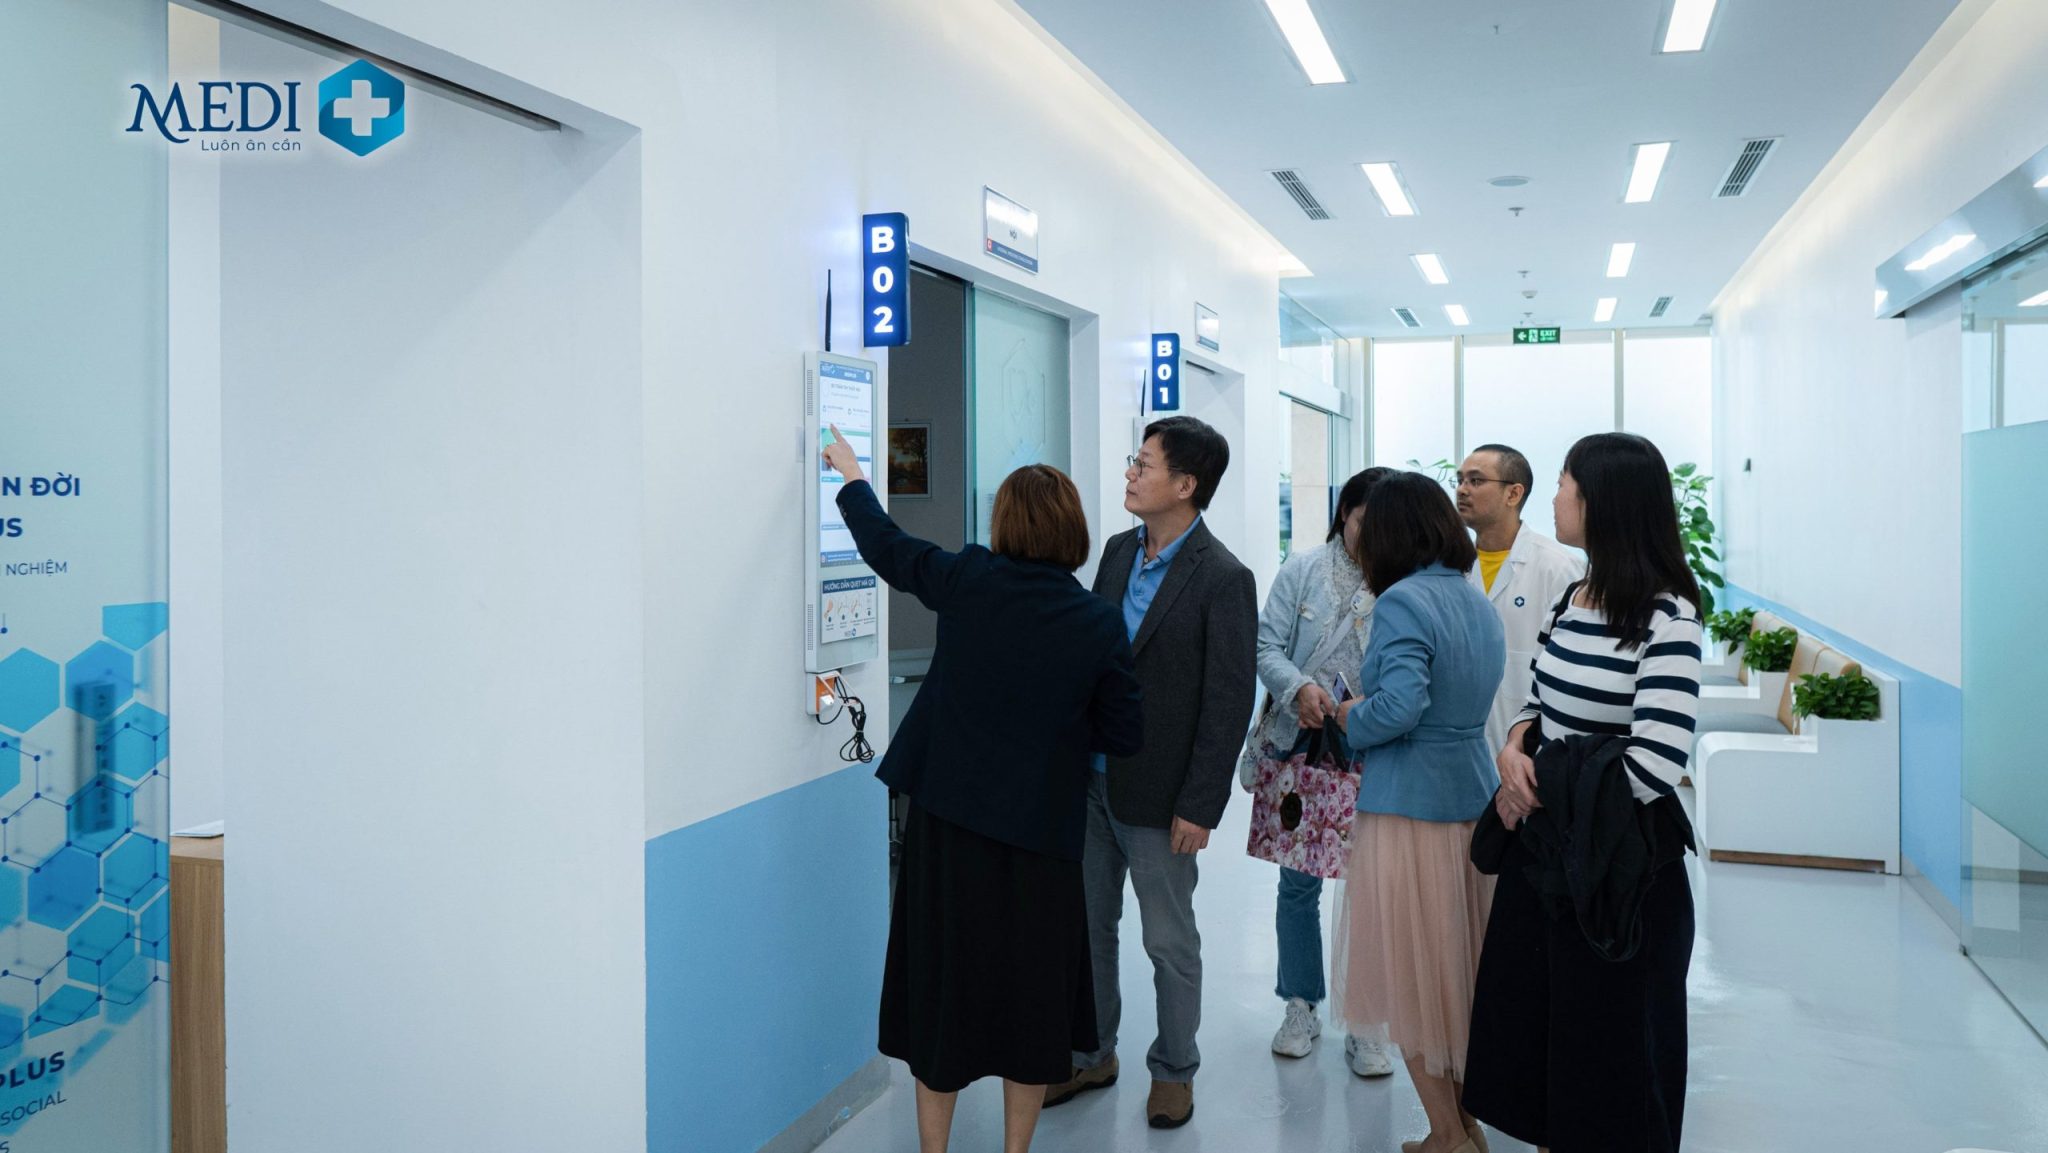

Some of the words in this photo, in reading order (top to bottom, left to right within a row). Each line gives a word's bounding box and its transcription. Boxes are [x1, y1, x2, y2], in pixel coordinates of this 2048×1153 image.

[871, 226, 895, 333] B02
[1157, 340, 1173, 404] B01
[30, 472, 80, 496] ĐỜI
[6, 558, 68, 577] NGHIỆM
[0, 1091, 67, 1126] SOCIAL
